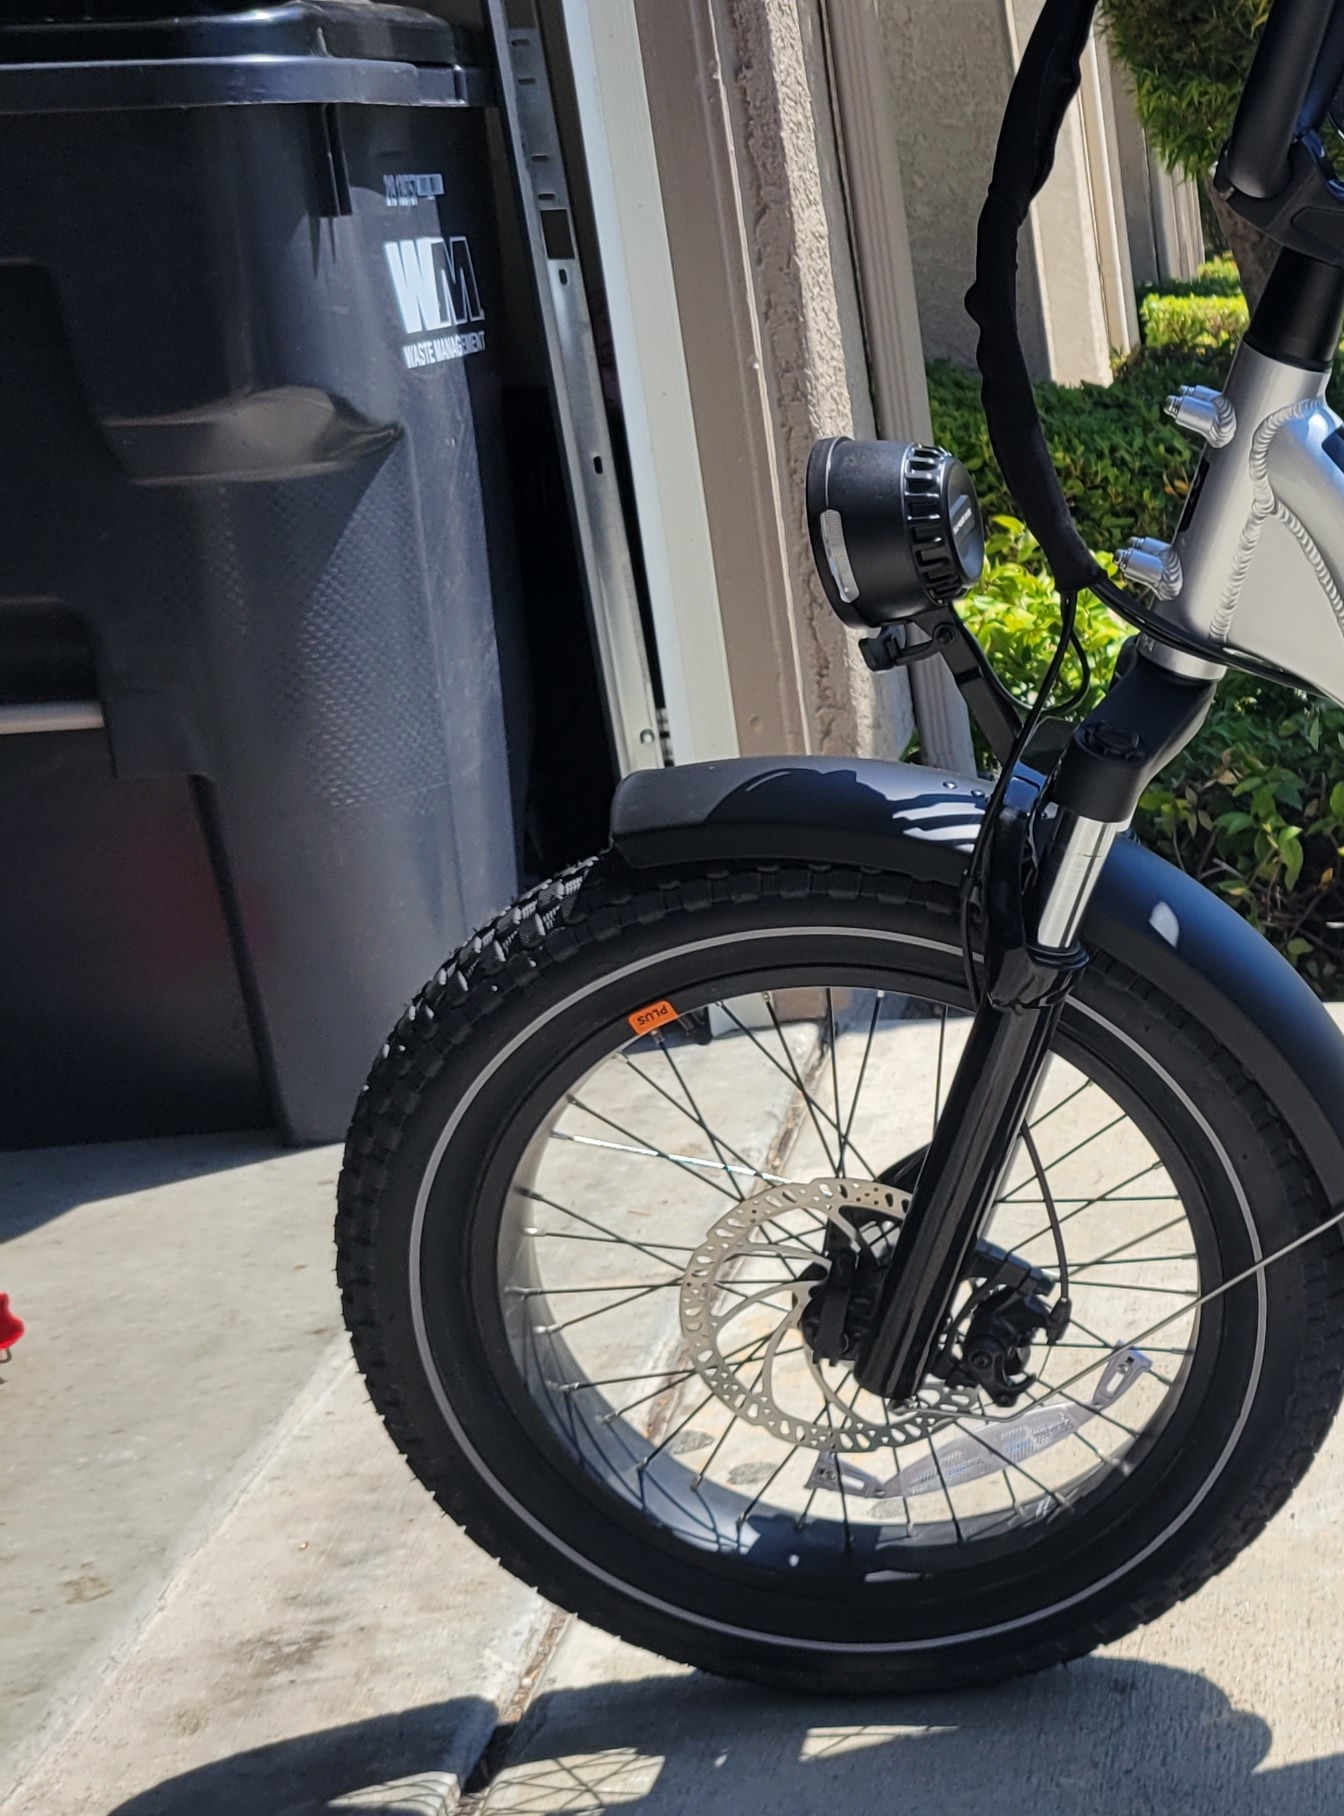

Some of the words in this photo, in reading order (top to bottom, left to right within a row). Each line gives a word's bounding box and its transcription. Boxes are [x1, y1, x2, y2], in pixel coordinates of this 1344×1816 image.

[384, 236, 484, 334] WM
[403, 340, 436, 369] WASTE
[433, 331, 485, 362] MANAGEMENT
[637, 1005, 668, 1026] PLUS
